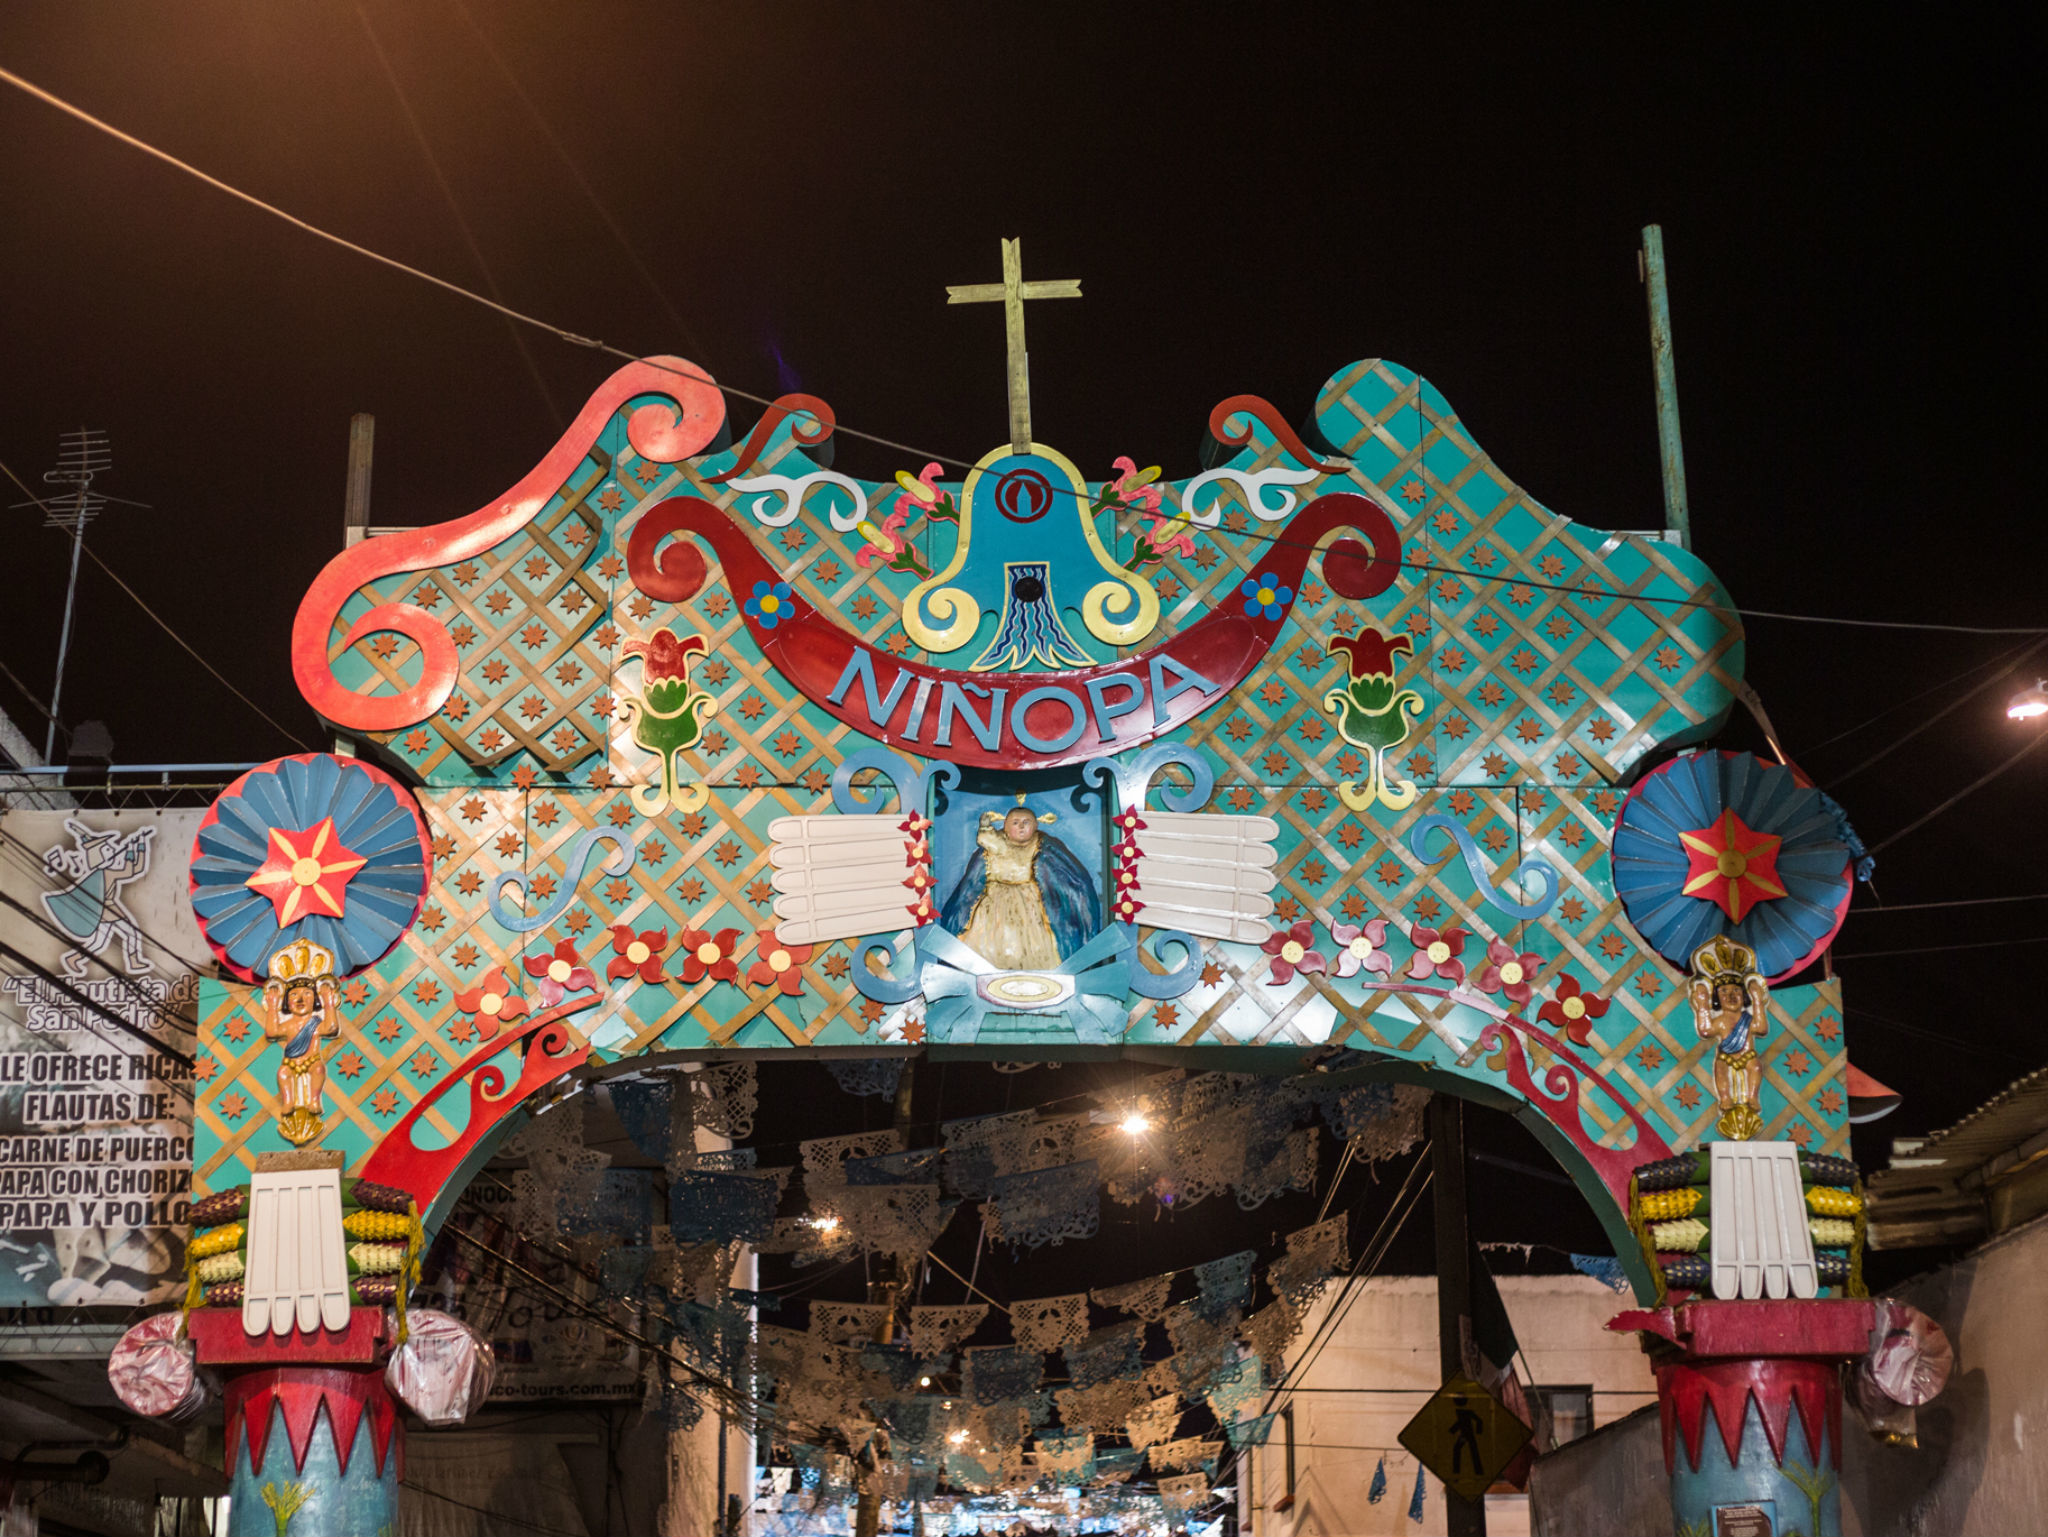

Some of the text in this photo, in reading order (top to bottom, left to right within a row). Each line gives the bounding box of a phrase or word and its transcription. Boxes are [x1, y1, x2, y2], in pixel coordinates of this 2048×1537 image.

[824, 644, 1222, 754] NIÑOPA
[28, 1004, 80, 1031] San
[1, 1055, 25, 1082] LE
[32, 1054, 122, 1082] OFRECE
[26, 1093, 175, 1122] FLAUTAS DE:
[0, 1137, 70, 1163] CARNE
[76, 1137, 104, 1162] DE
[0, 1169, 193, 1195] APA CON CHORIZ
[0, 1202, 71, 1226] PAPA
[80, 1202, 97, 1226] Y
